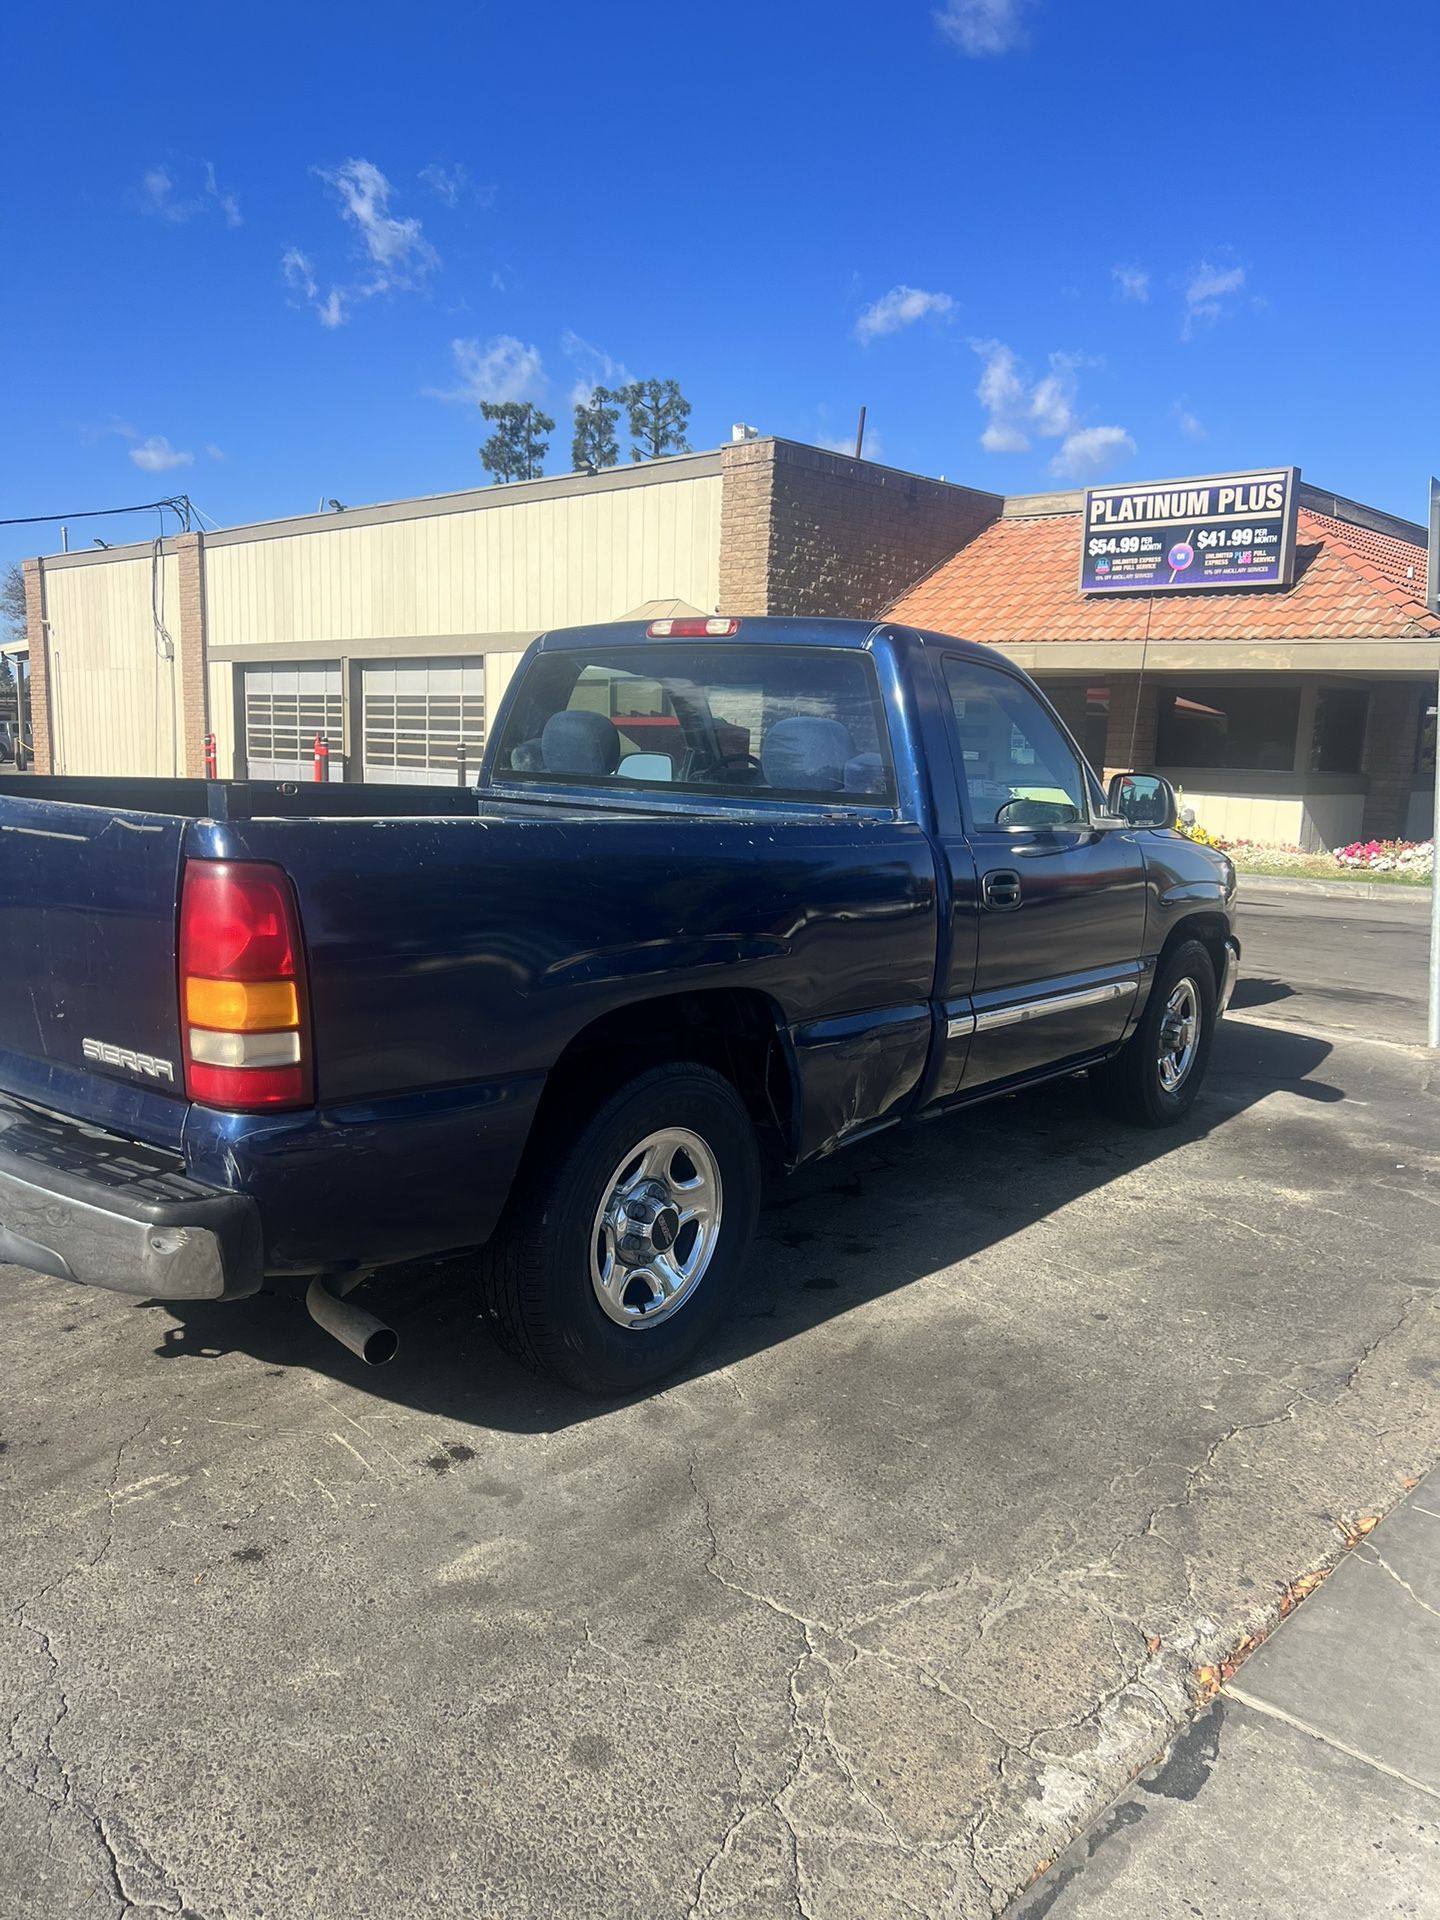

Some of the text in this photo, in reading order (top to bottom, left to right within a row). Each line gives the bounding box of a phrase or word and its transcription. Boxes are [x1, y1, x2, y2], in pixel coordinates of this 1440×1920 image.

[1090, 483, 1283, 524] PLATINUM PLUS
[1254, 528, 1268, 537] PER
[1141, 536, 1153, 545] PER
[1197, 528, 1253, 550] $41.99
[1254, 535, 1278, 545] MONTH
[1088, 536, 1140, 557] $54.99
[1140, 543, 1162, 552] MONTH
[1252, 556, 1276, 564] SERVICE
[82, 1037, 175, 1083] SIERRA
